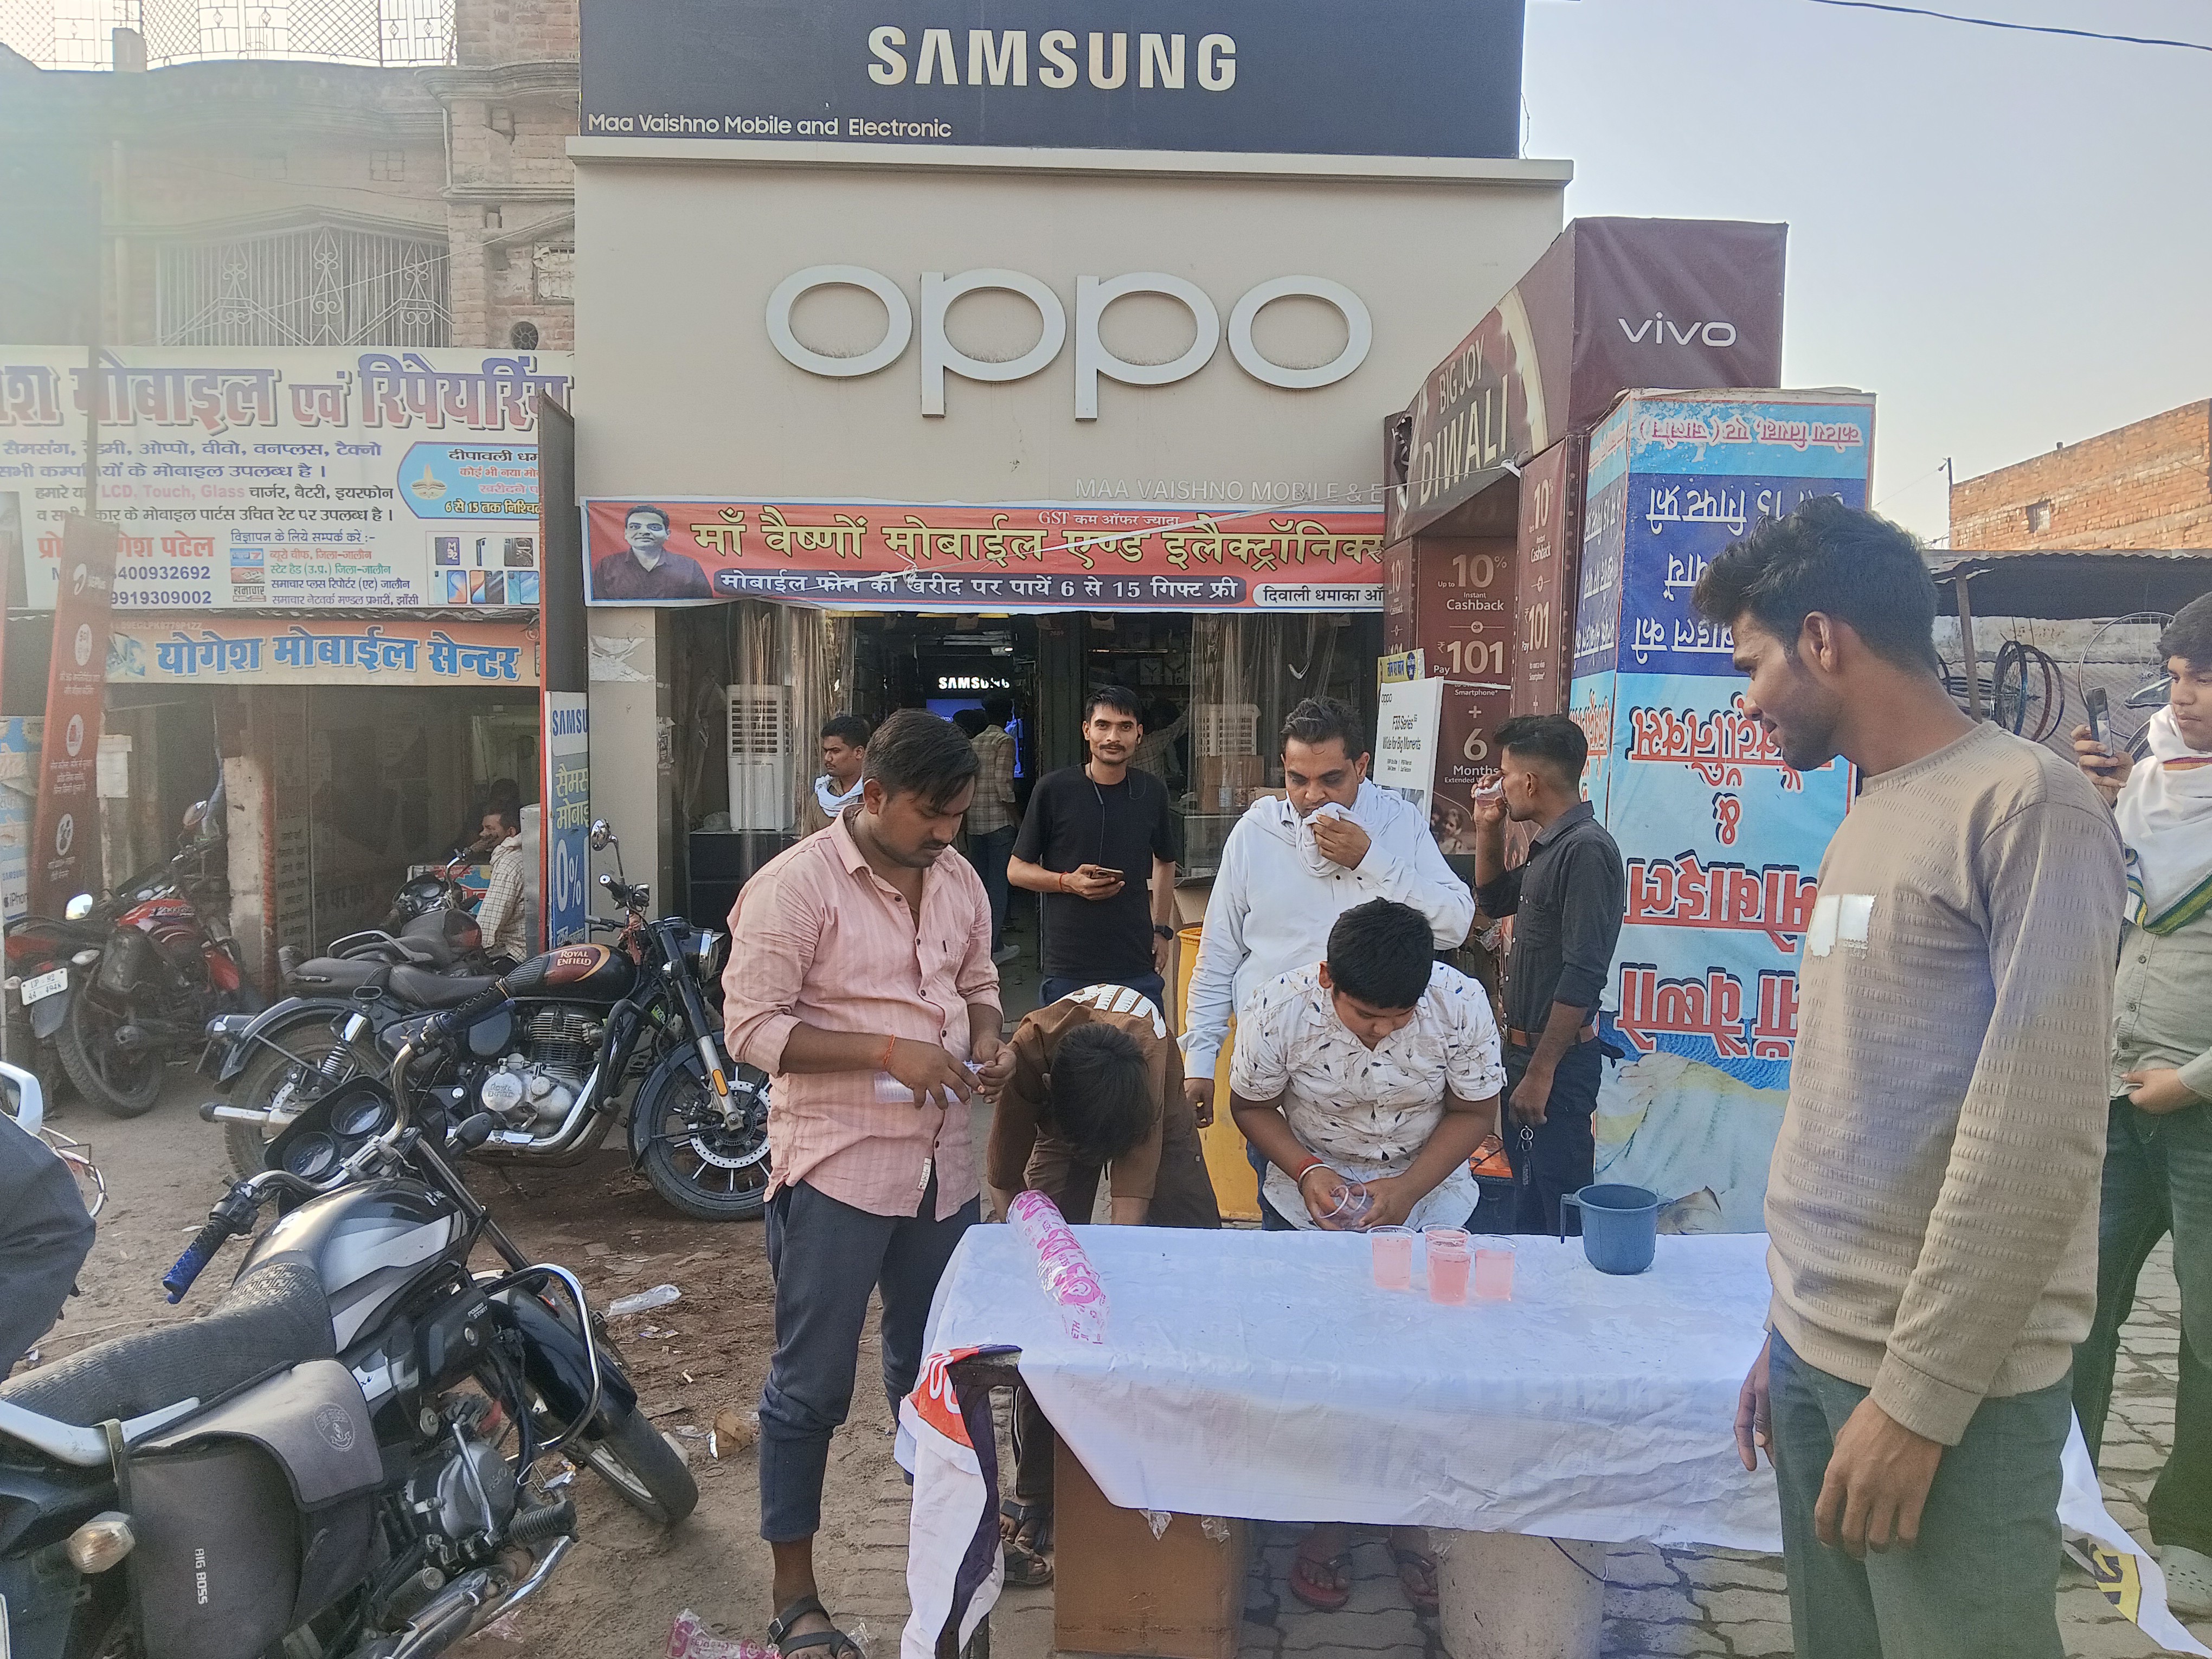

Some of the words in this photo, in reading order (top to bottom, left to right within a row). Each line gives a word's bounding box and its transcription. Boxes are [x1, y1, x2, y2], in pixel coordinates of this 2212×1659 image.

[867, 25, 1238, 91] SAMSUNG
[588, 113, 634, 132] Maa
[638, 113, 720, 134] Vaishno
[724, 114, 791, 136] Mobile
[797, 115, 838, 136] and
[848, 117, 952, 139] Electronic
[1619, 313, 1737, 347] vivo
[765, 264, 1373, 421] oppo
[1438, 362, 1457, 414] BIG
[1459, 334, 1486, 396] JOY
[289, 370, 348, 423] एवं
[1420, 375, 1509, 507] DIWALI
[449, 448, 512, 461] दीपावली
[127, 462, 147, 477] के
[229, 466, 293, 477] उपलब्ध
[298, 462, 312, 478] है
[101, 485, 137, 499] LCD,
[143, 484, 196, 500] Touch,
[201, 484, 245, 498] Glass
[1076, 479, 1129, 499] MAA
[1137, 479, 1244, 501] VAISHNO
[1251, 481, 1339, 503] MOBILE
[1346, 484, 1362, 503] &
[124, 506, 138, 520] के
[298, 510, 317, 521] पर
[320, 510, 368, 521] उपलब्ध
[468, 502, 479, 512] 15
[1039, 511, 1069, 525] GST
[1074, 514, 1097, 526] कम
[1102, 511, 1139, 526] ऑफर
[160, 530, 215, 557] पटेल
[275, 529, 285, 541] के
[691, 507, 746, 556] माँ
[880, 513, 1047, 567] मोबाईल
[114, 565, 211, 580] 400932692
[870, 571, 897, 594] की
[970, 578, 1002, 596] पर
[1009, 575, 1053, 597] पायें
[1060, 580, 1074, 597] 6
[1083, 576, 1103, 598] से
[1113, 580, 1140, 598] 15
[1150, 577, 1204, 598] गिफ्ट
[1210, 579, 1239, 601] फ्री
[1264, 584, 1310, 602] दिवाली
[1315, 590, 1360, 603] धमाका
[1446, 599, 1504, 611] Cashback
[156, 632, 266, 674] योगेश
[427, 632, 520, 679] सेन्टर
[1433, 665, 1450, 676] Pay
[1463, 728, 1488, 761] 6
[1453, 765, 1499, 776] Months
[1716, 795, 1741, 843] &
[557, 957, 592, 967] ENFIELD
[194, 1547, 206, 1568] BIG
[196, 1570, 209, 1605] BOSS
